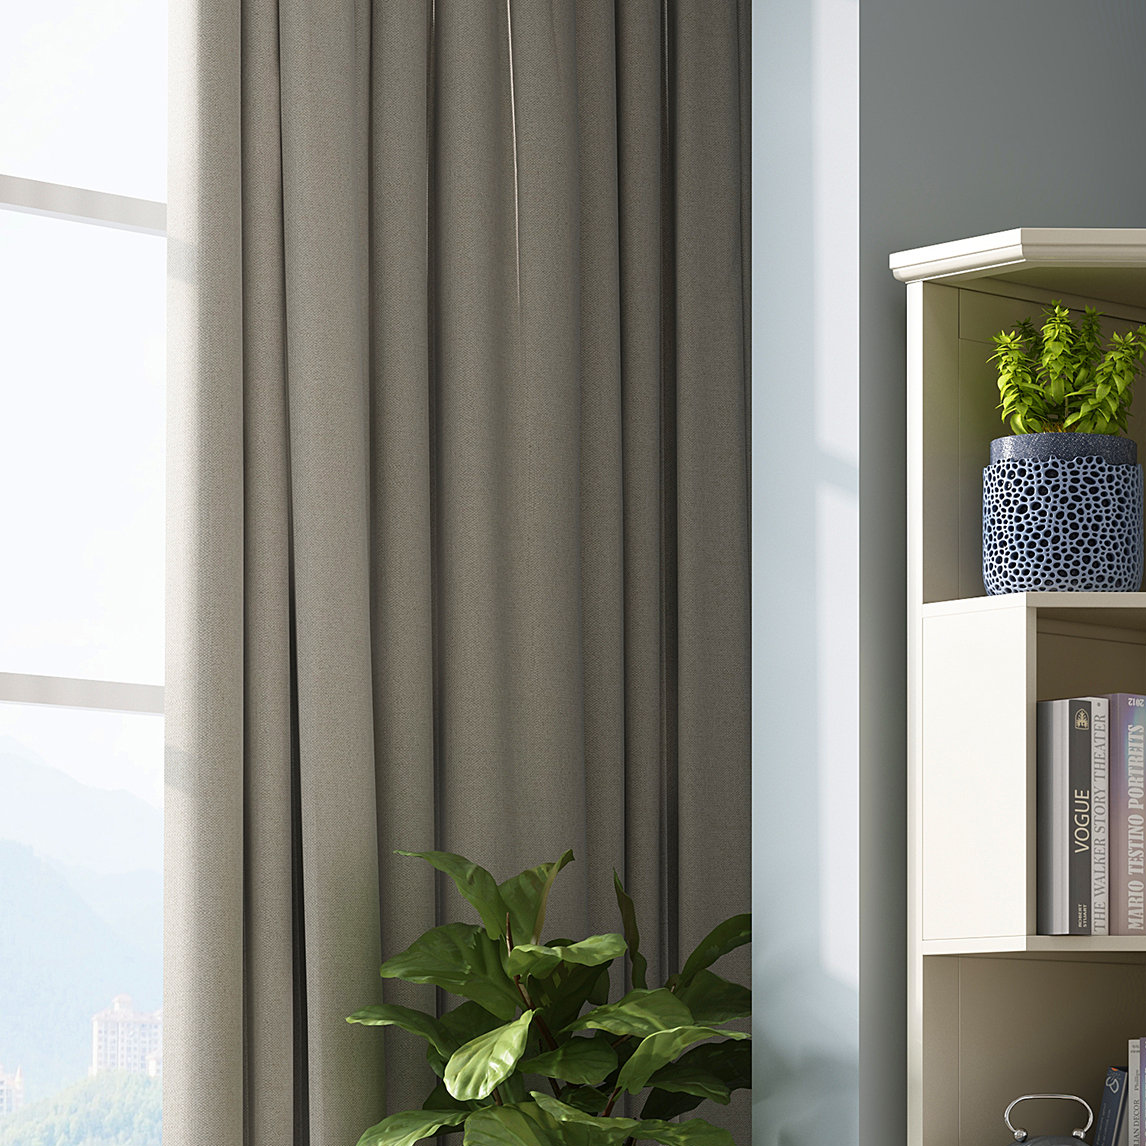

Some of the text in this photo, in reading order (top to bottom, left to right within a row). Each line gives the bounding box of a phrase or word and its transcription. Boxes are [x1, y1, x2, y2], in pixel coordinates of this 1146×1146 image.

[1128, 697, 1144, 707] 2012
[1074, 789, 1090, 853] VOGUE
[1093, 715, 1106, 932] THE WALKER STORY THEATER
[1128, 724, 1144, 930] MARIO TESTINO PORTREITS
